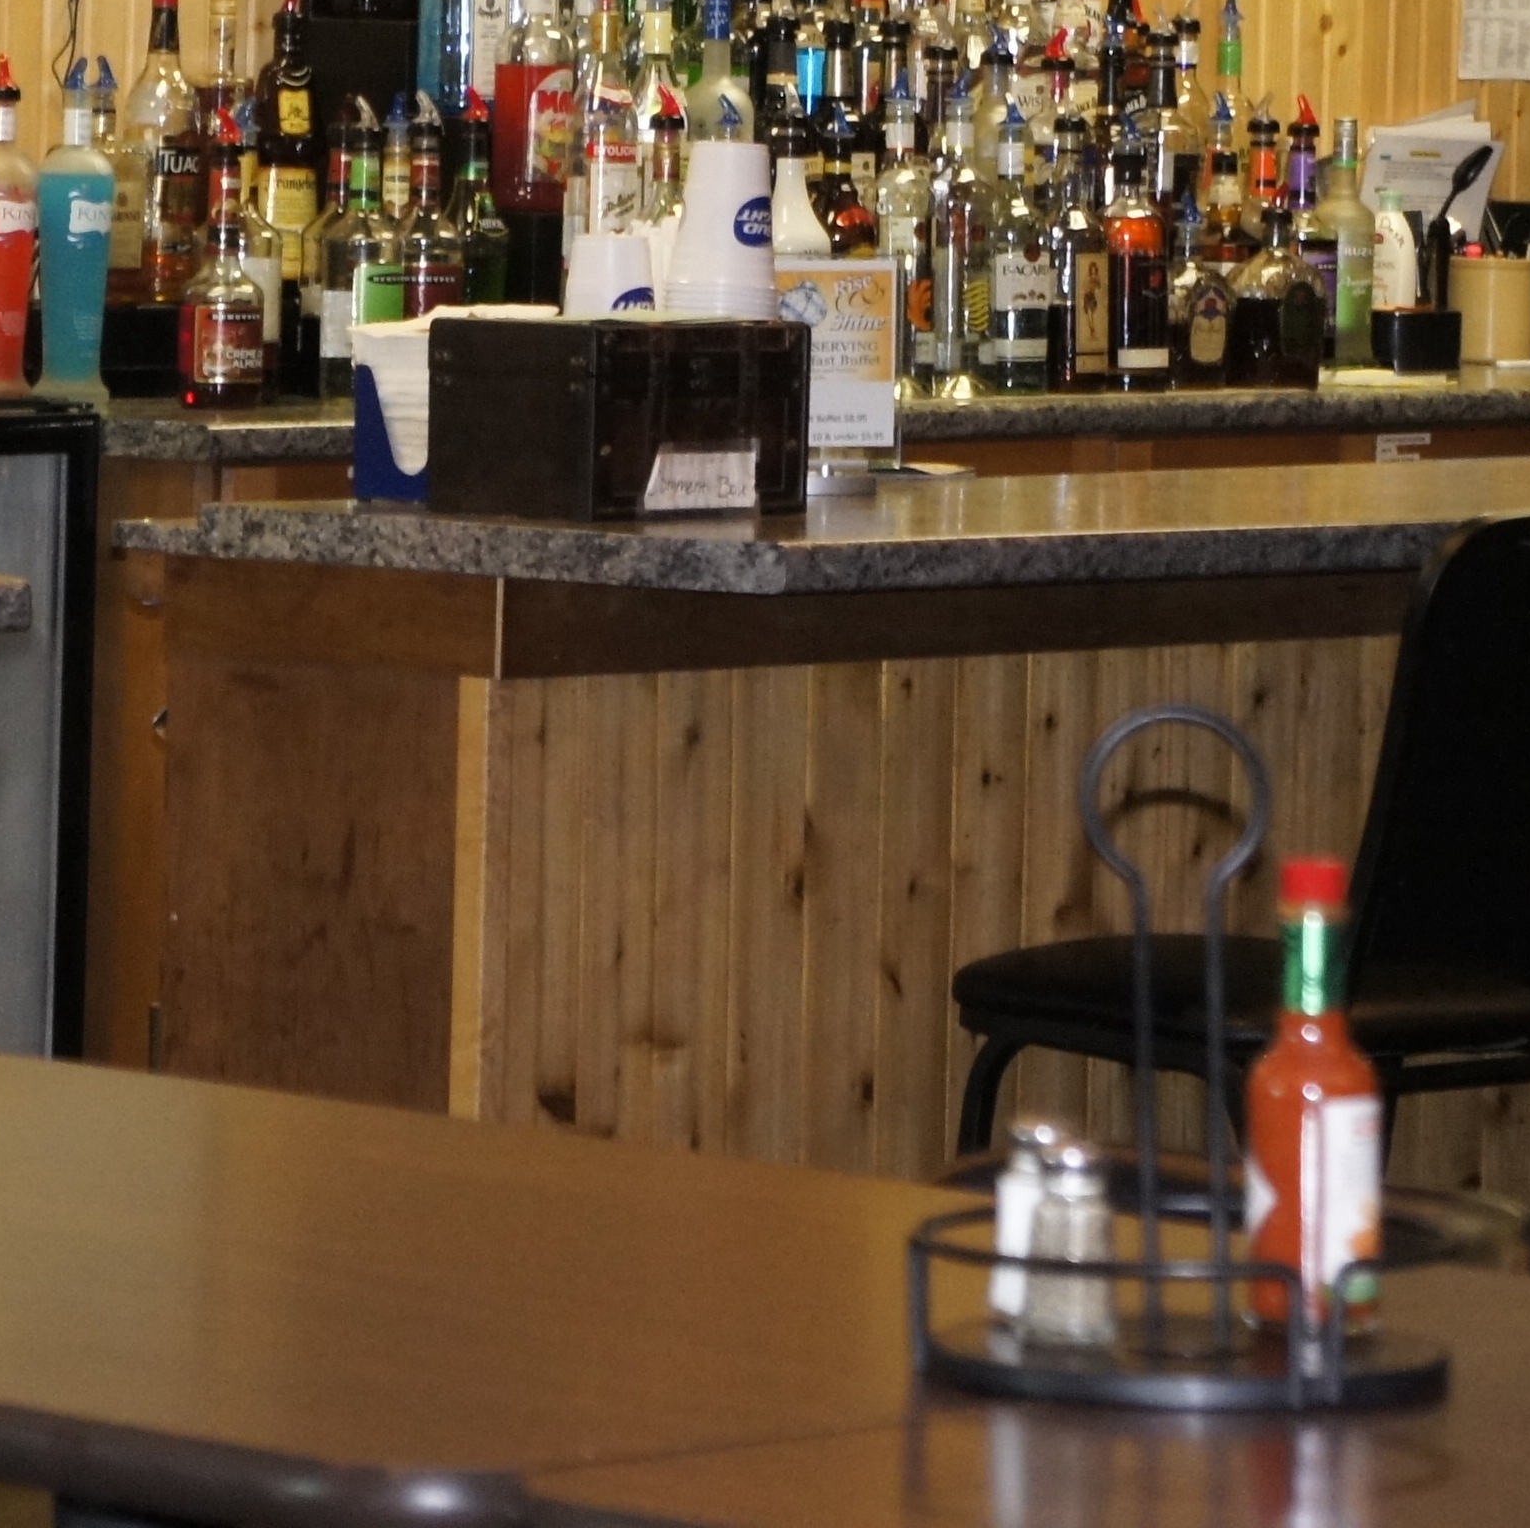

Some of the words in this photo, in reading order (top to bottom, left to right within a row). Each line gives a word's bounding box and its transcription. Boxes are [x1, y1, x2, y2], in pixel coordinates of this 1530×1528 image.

[833, 275, 874, 295] Rise
[830, 315, 886, 332] Shine
[810, 341, 879, 353] SERVING
[840, 355, 881, 367] Buffet
